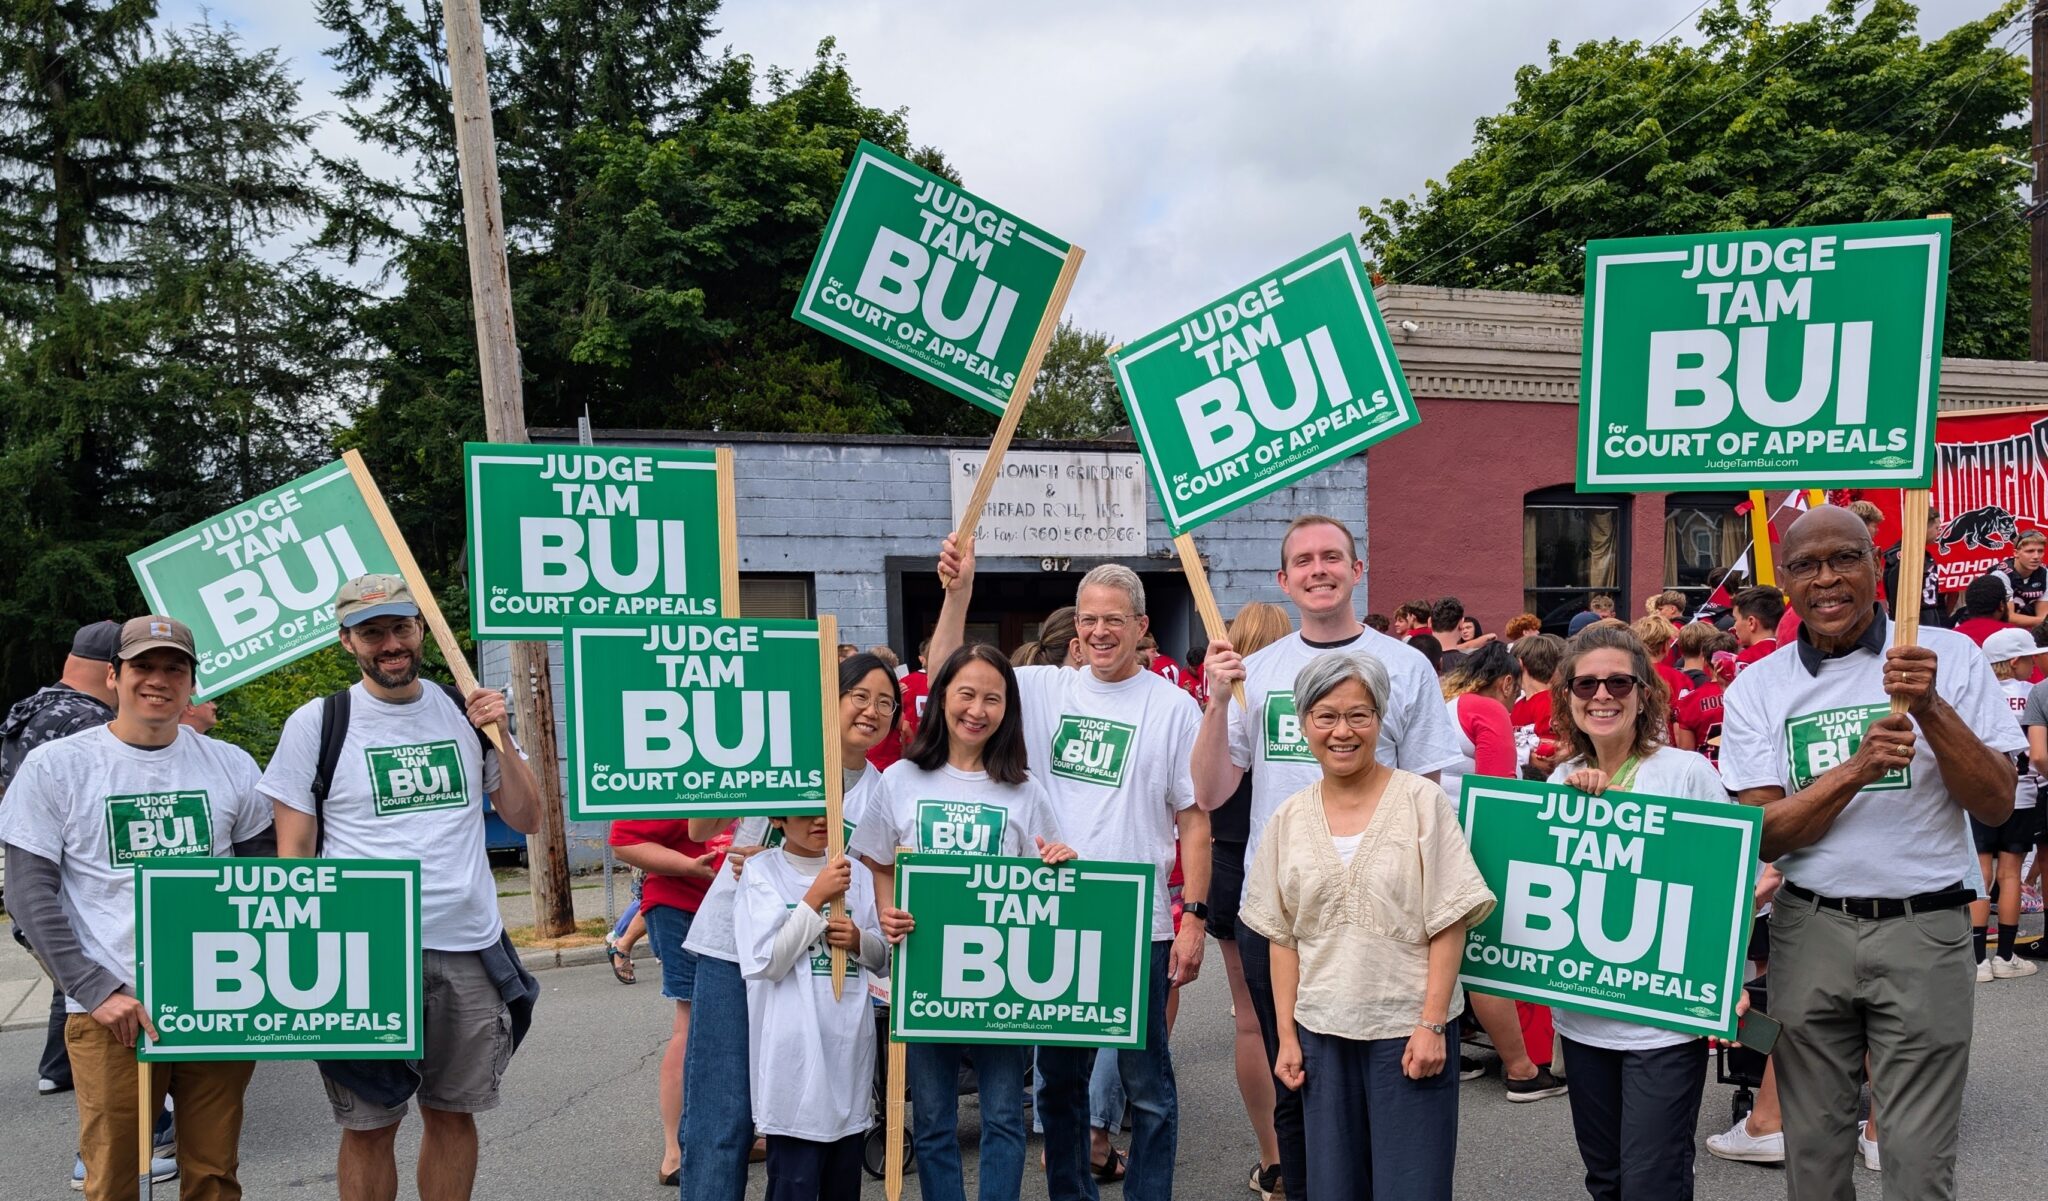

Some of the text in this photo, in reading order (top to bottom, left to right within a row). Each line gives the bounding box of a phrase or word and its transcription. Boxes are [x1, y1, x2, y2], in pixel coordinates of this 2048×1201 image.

[914, 181, 1017, 247] JUDGE
[919, 209, 994, 271] TAM
[1682, 236, 1837, 279] JUDGE
[828, 276, 843, 289] for
[854, 225, 1020, 360] BUI
[1179, 278, 1284, 352] JUDGE
[1696, 277, 1812, 325] TAM
[821, 287, 1015, 390] COURT OF APPEALS
[885, 336, 946, 369] JudgeTamBui.com
[1194, 314, 1282, 377] TAM
[1646, 321, 1873, 430] BUI
[1176, 325, 1353, 470] BUI
[1604, 428, 1907, 457] COURT OF APPEALS
[1608, 423, 1628, 434] for
[1175, 390, 1388, 501] COURT OF APPEALS
[540, 454, 653, 482] JUDGE
[1253, 444, 1320, 480] JudgeTamBui.com
[1705, 457, 1799, 470] JudgeTamBui.com
[1045, 484, 1055, 497] &
[1173, 472, 1188, 484] for
[553, 483, 639, 517] TAM
[201, 489, 302, 550] JUDGE
[216, 517, 302, 570] TAM
[520, 517, 687, 595] BUI
[198, 525, 367, 647] BUI
[492, 586, 508, 595] for
[490, 596, 716, 615] COURT OF APPEALS
[200, 617, 308, 675] COURT OF
[642, 625, 759, 652] JUDGE
[656, 655, 744, 688] TAM
[622, 691, 792, 769] BUI
[1077, 719, 1111, 731] JUDGE
[1816, 709, 1868, 727] JUDGE
[1822, 721, 1861, 740] TAM
[1080, 729, 1104, 741] TAM
[1270, 744, 1295, 752] COURT
[392, 746, 432, 758] JUDGE
[397, 756, 429, 768] TAM
[1062, 739, 1115, 769] BUI
[591, 770, 822, 791] COURT OF APPEALS
[593, 763, 609, 771] for
[1054, 760, 1074, 769] COURT
[1085, 766, 1117, 778] APPEALS
[388, 766, 451, 797] BUI
[675, 791, 747, 800] JudgeTamBui.com
[134, 794, 178, 807] JUDGE
[140, 806, 174, 819] TAM
[382, 797, 411, 806] COURT
[425, 792, 461, 802] APPEALS
[942, 803, 981, 813] JUDGE
[946, 812, 975, 824] TAM
[1537, 793, 1667, 835] JUDGE
[128, 816, 197, 851] BUI
[933, 822, 990, 852] BUI
[118, 850, 152, 859] COURT
[168, 845, 209, 855] APPEALS
[1549, 826, 1645, 874] TAM
[215, 866, 337, 893] JUDGE
[966, 864, 1076, 893] JUDGE
[228, 896, 320, 929] TAM
[977, 893, 1059, 926] TAM
[1501, 859, 1693, 974] BUI
[1469, 931, 1486, 942] for
[192, 932, 370, 1011] BUI
[941, 925, 1102, 1003] BUI
[1465, 943, 1717, 1004] COURT OF APPEALS
[912, 990, 927, 999] for
[1547, 978, 1626, 999] JudgeTamBui.com
[158, 1013, 401, 1032] COURT OF APPEALS
[161, 1004, 178, 1013] for
[910, 1001, 1126, 1024] COURT OF APPEALS
[245, 1034, 320, 1042] JudgeTamBui.com
[985, 1022, 1053, 1030] JudgeTamBui.com
